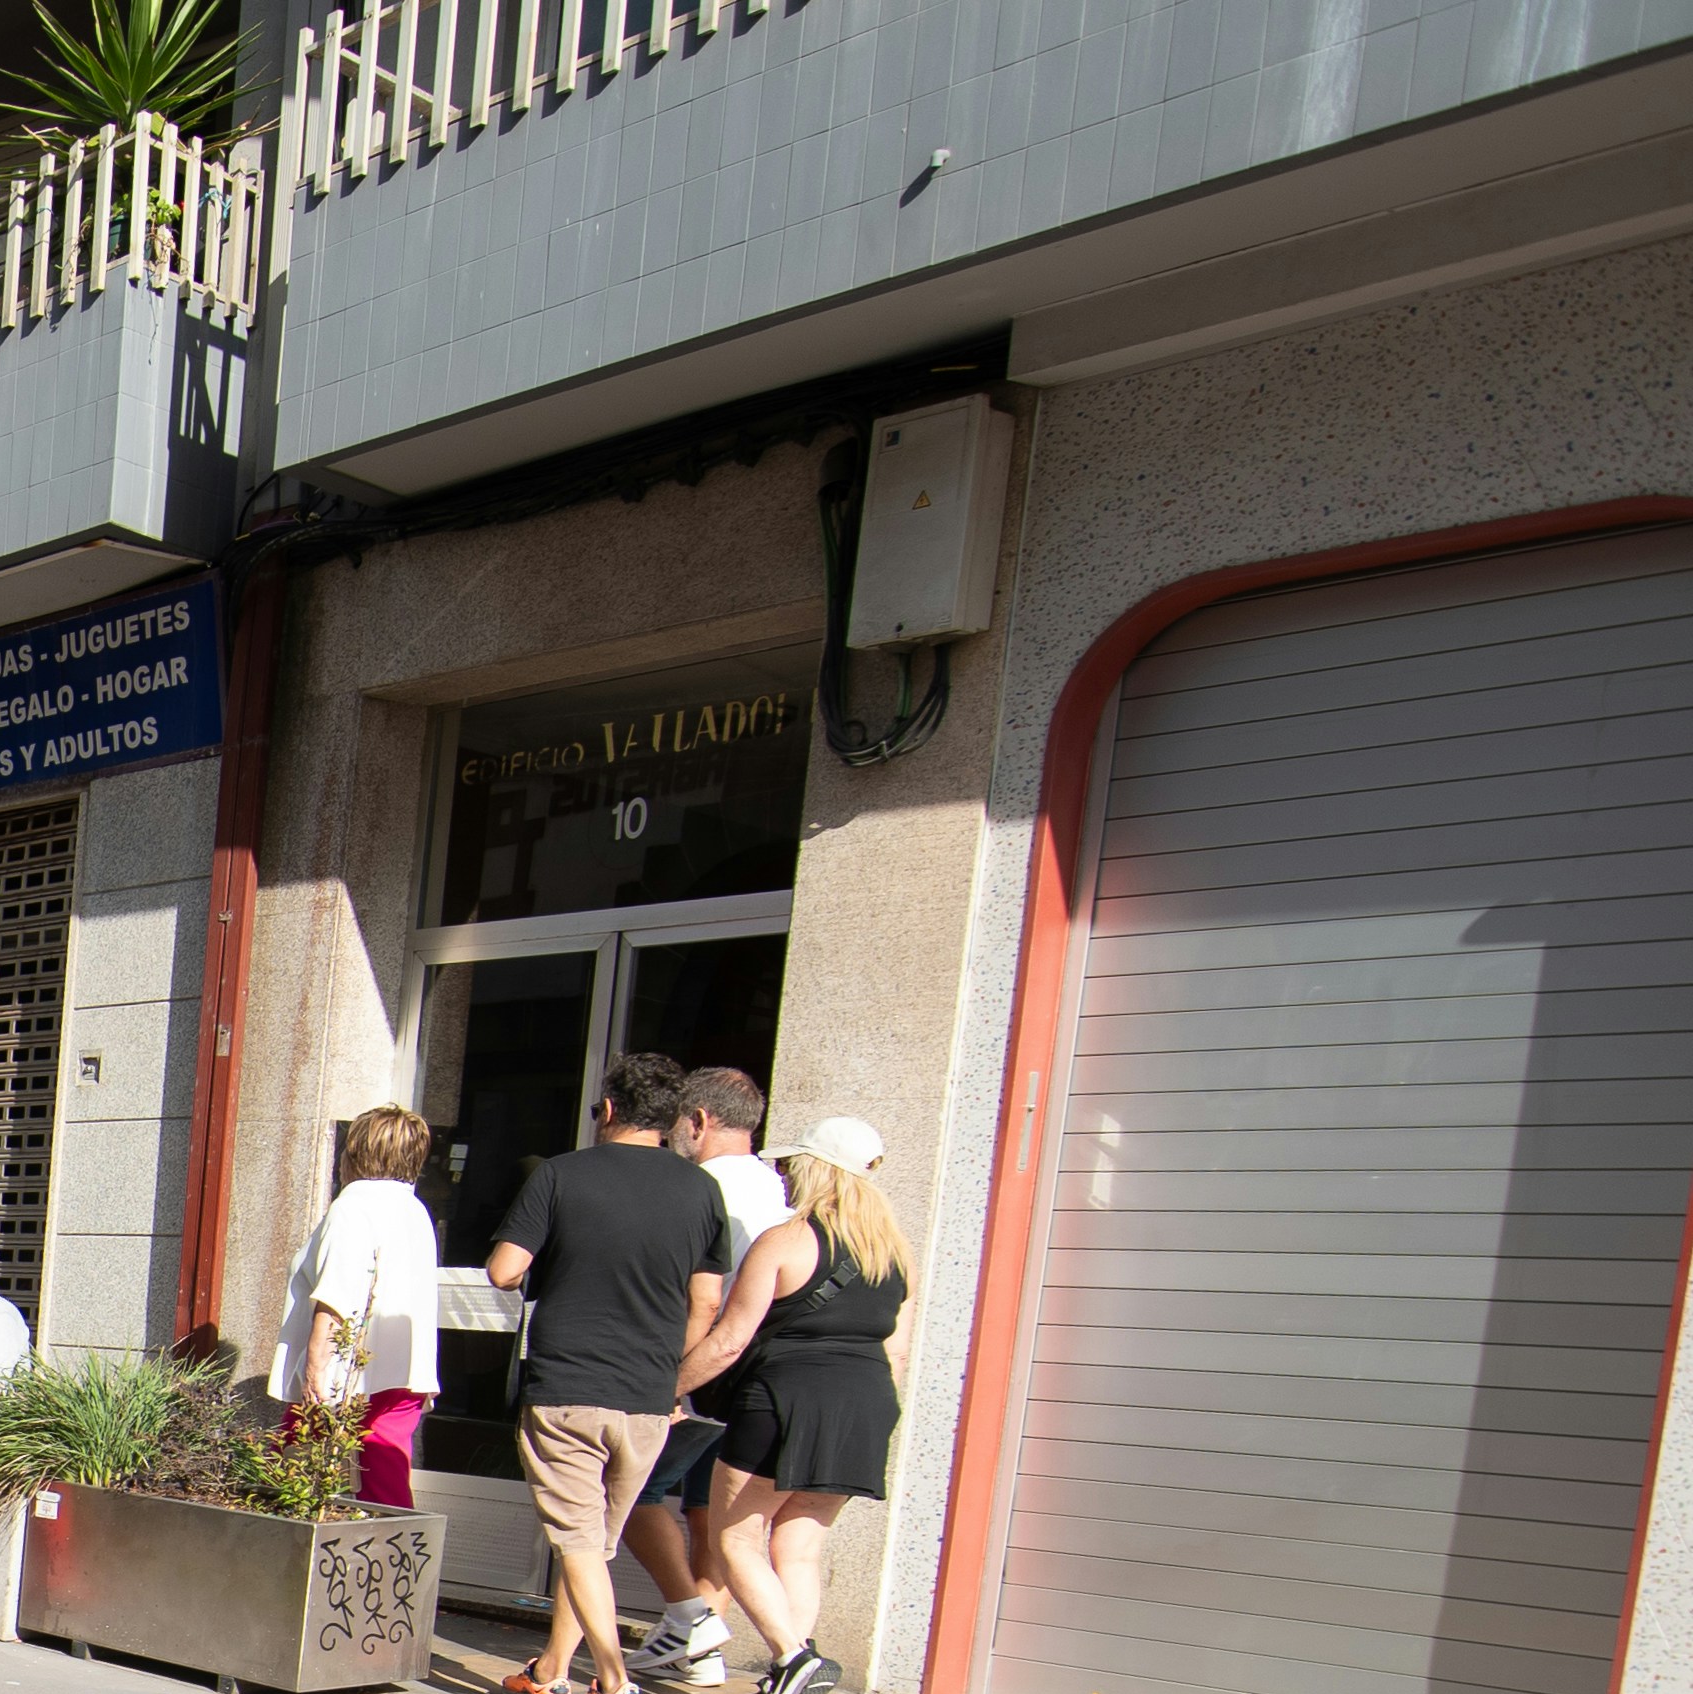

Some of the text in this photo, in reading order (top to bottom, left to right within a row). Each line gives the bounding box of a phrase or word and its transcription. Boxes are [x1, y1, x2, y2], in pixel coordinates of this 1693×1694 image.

[54, 600, 190, 663] JUGUETES
[96, 656, 189, 704] HOGAR
[19, 742, 37, 772] Y
[43, 716, 159, 768] ADULTOS
[461, 741, 584, 785] EDIFICIO
[612, 797, 648, 841] 10
